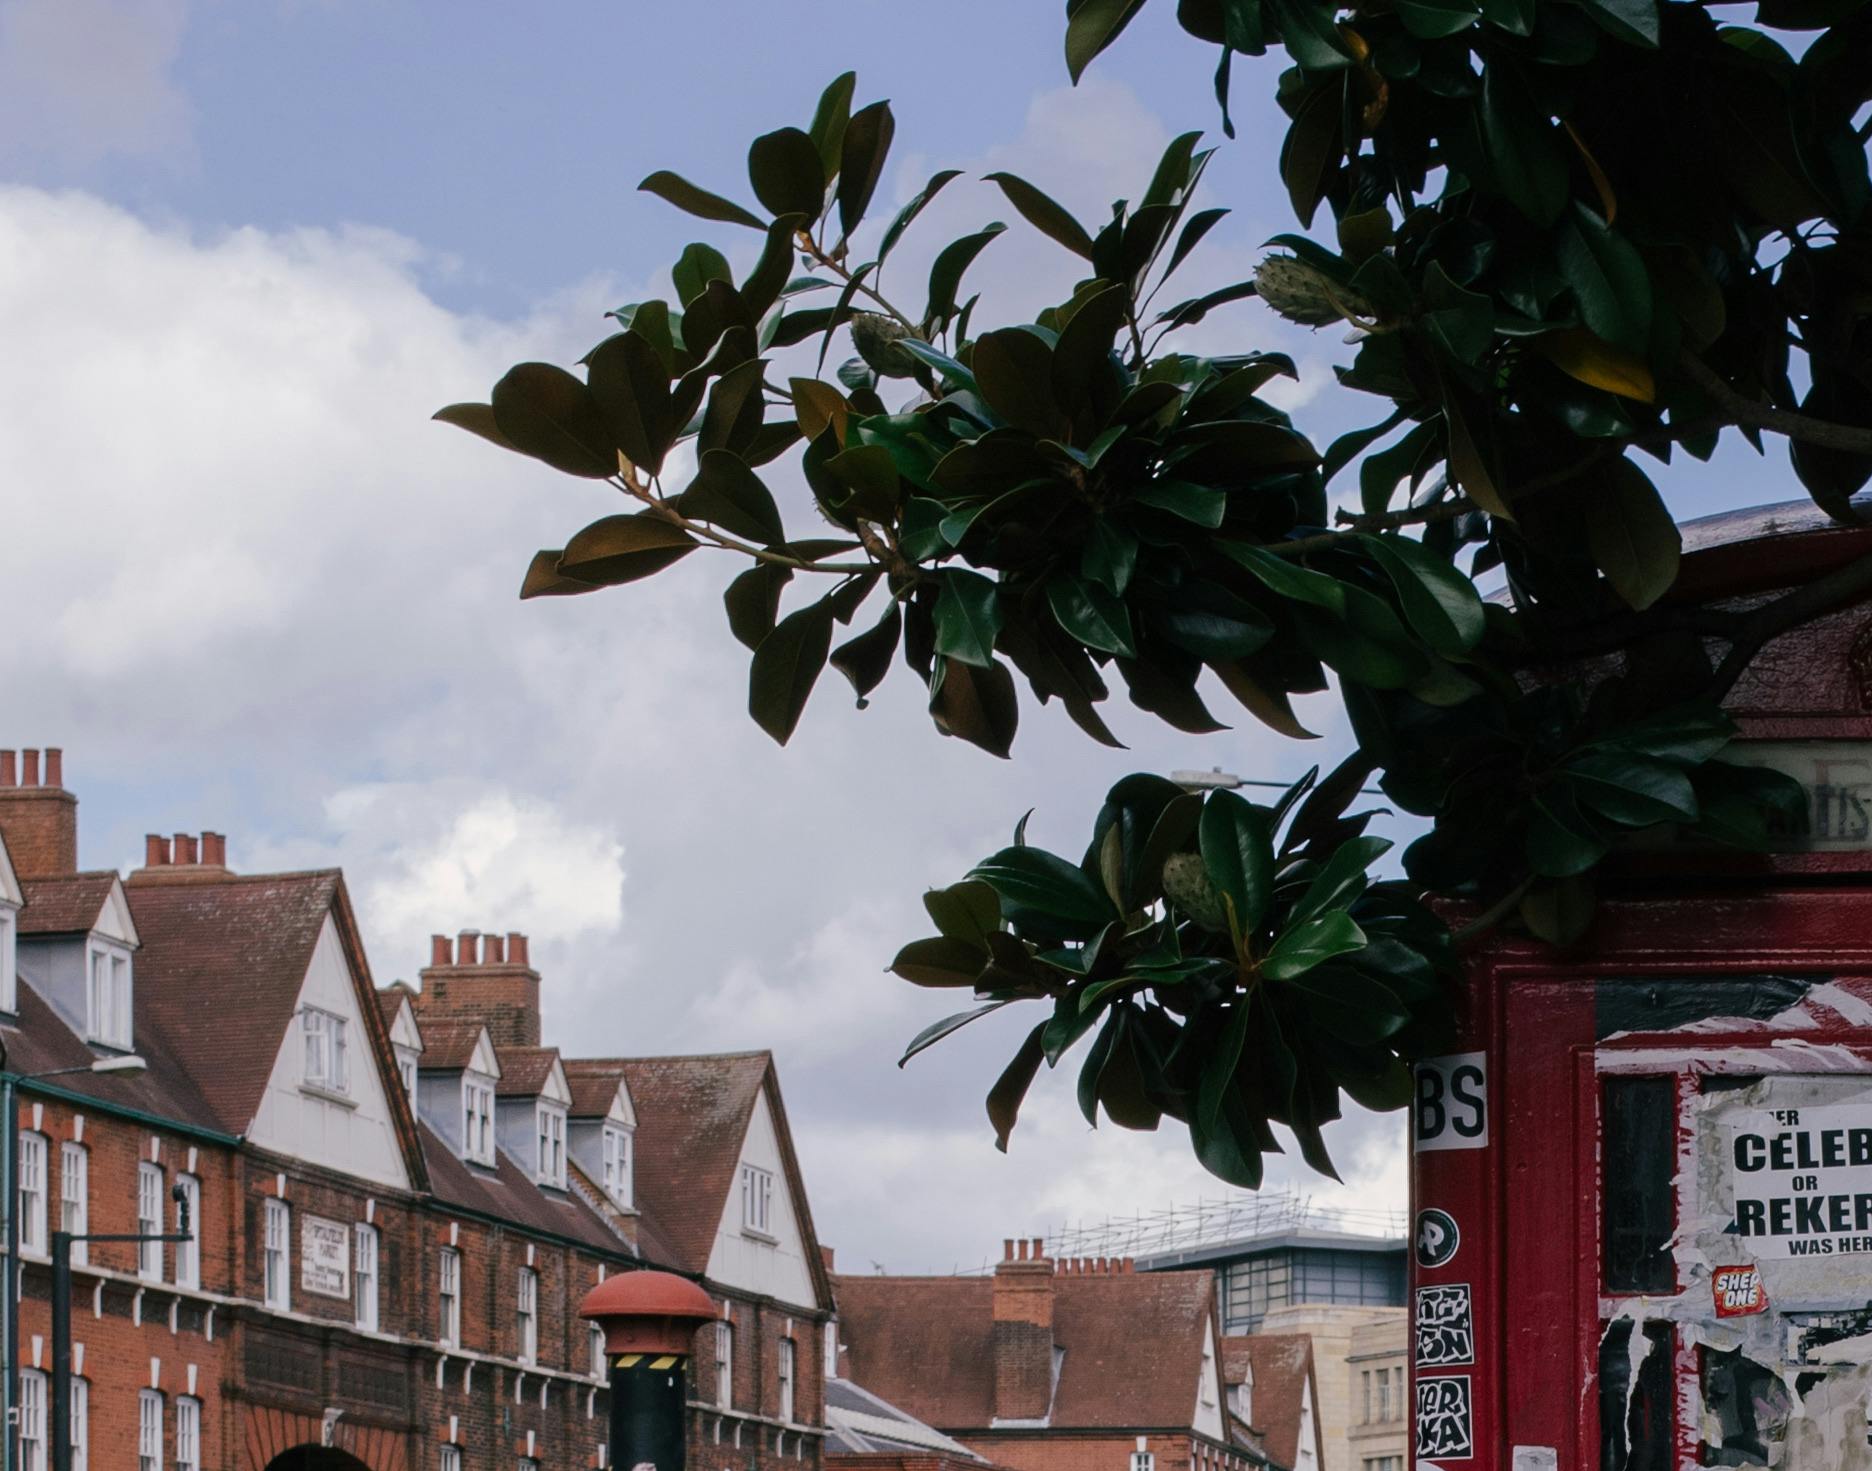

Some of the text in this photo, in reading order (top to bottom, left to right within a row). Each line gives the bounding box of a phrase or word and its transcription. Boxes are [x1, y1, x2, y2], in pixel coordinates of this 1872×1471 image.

[1792, 1175, 1818, 1191] OR
[1788, 1239, 1833, 1256] WAS
[1716, 1272, 1759, 1291] SHEP
[1724, 1289, 1757, 1306] ONE
